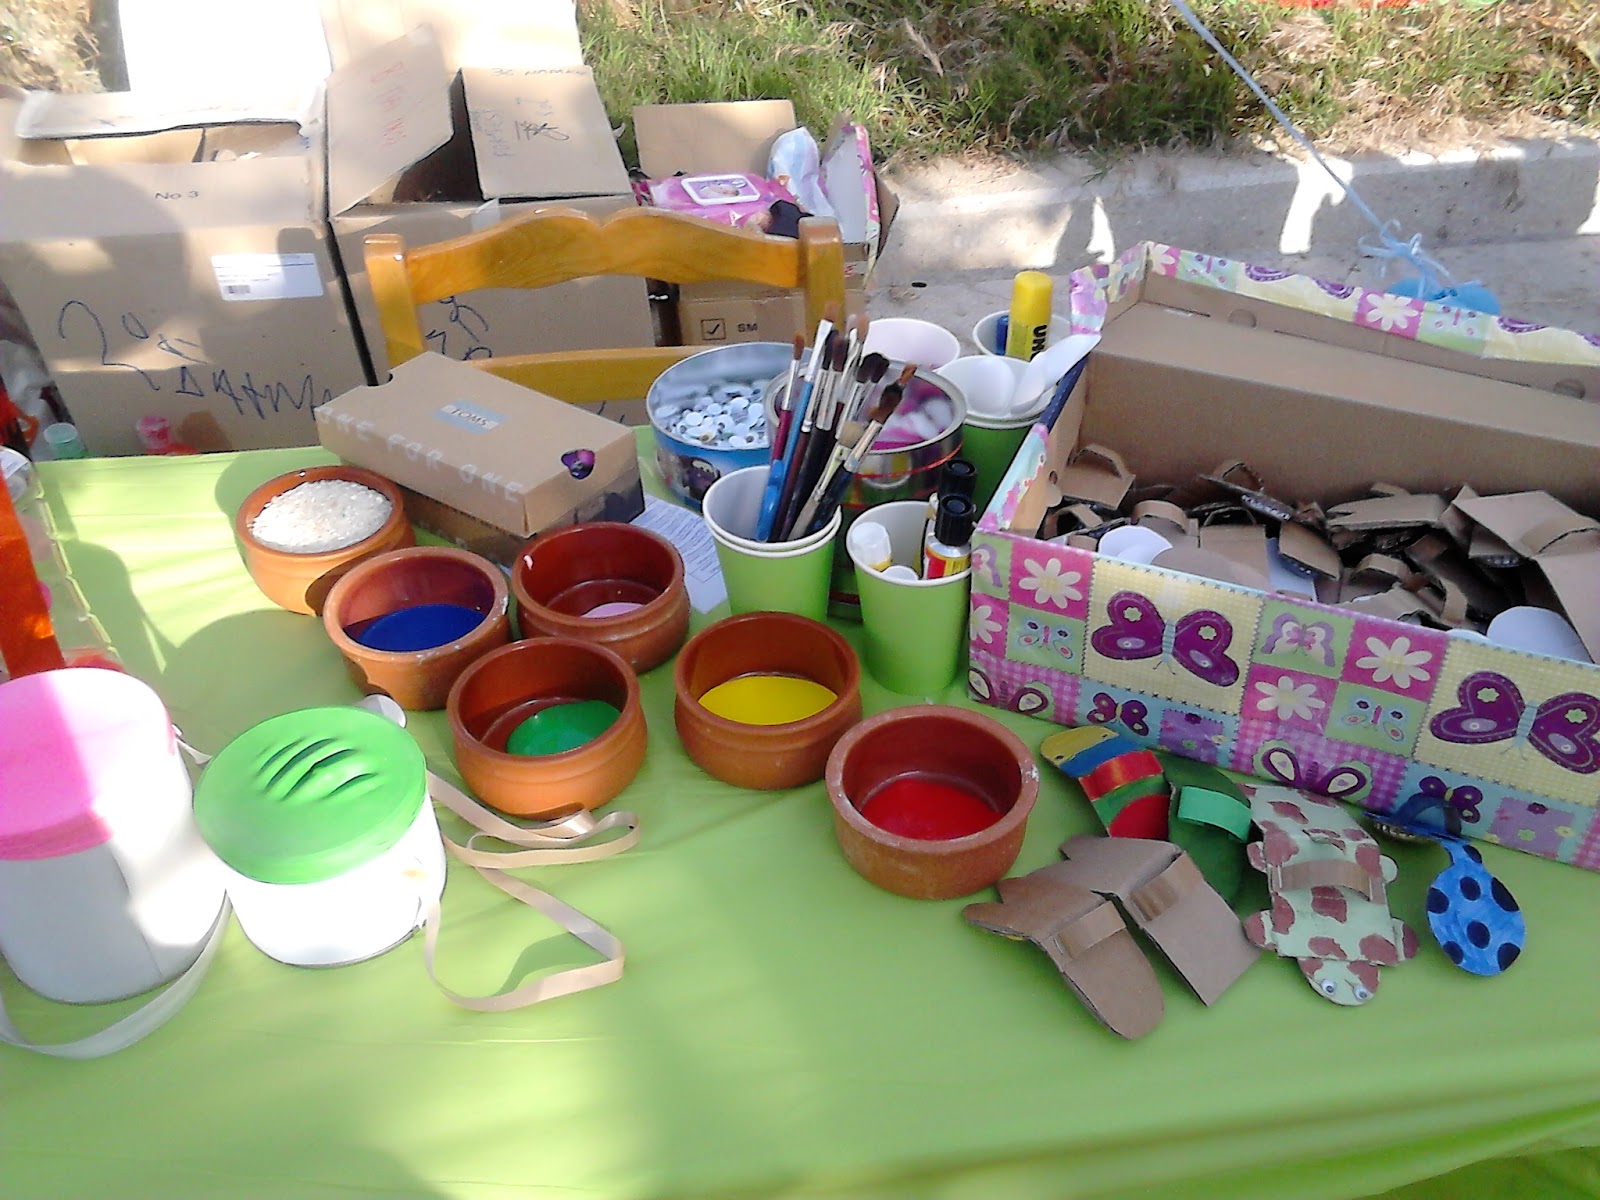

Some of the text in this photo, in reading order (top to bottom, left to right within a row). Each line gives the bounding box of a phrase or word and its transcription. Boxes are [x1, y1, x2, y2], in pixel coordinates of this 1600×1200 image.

[188, 190, 199, 199] 3
[737, 322, 758, 333] SM
[450, 408, 487, 426] TOMS
[387, 432, 445, 471] FOR
[458, 463, 524, 503] ONE
